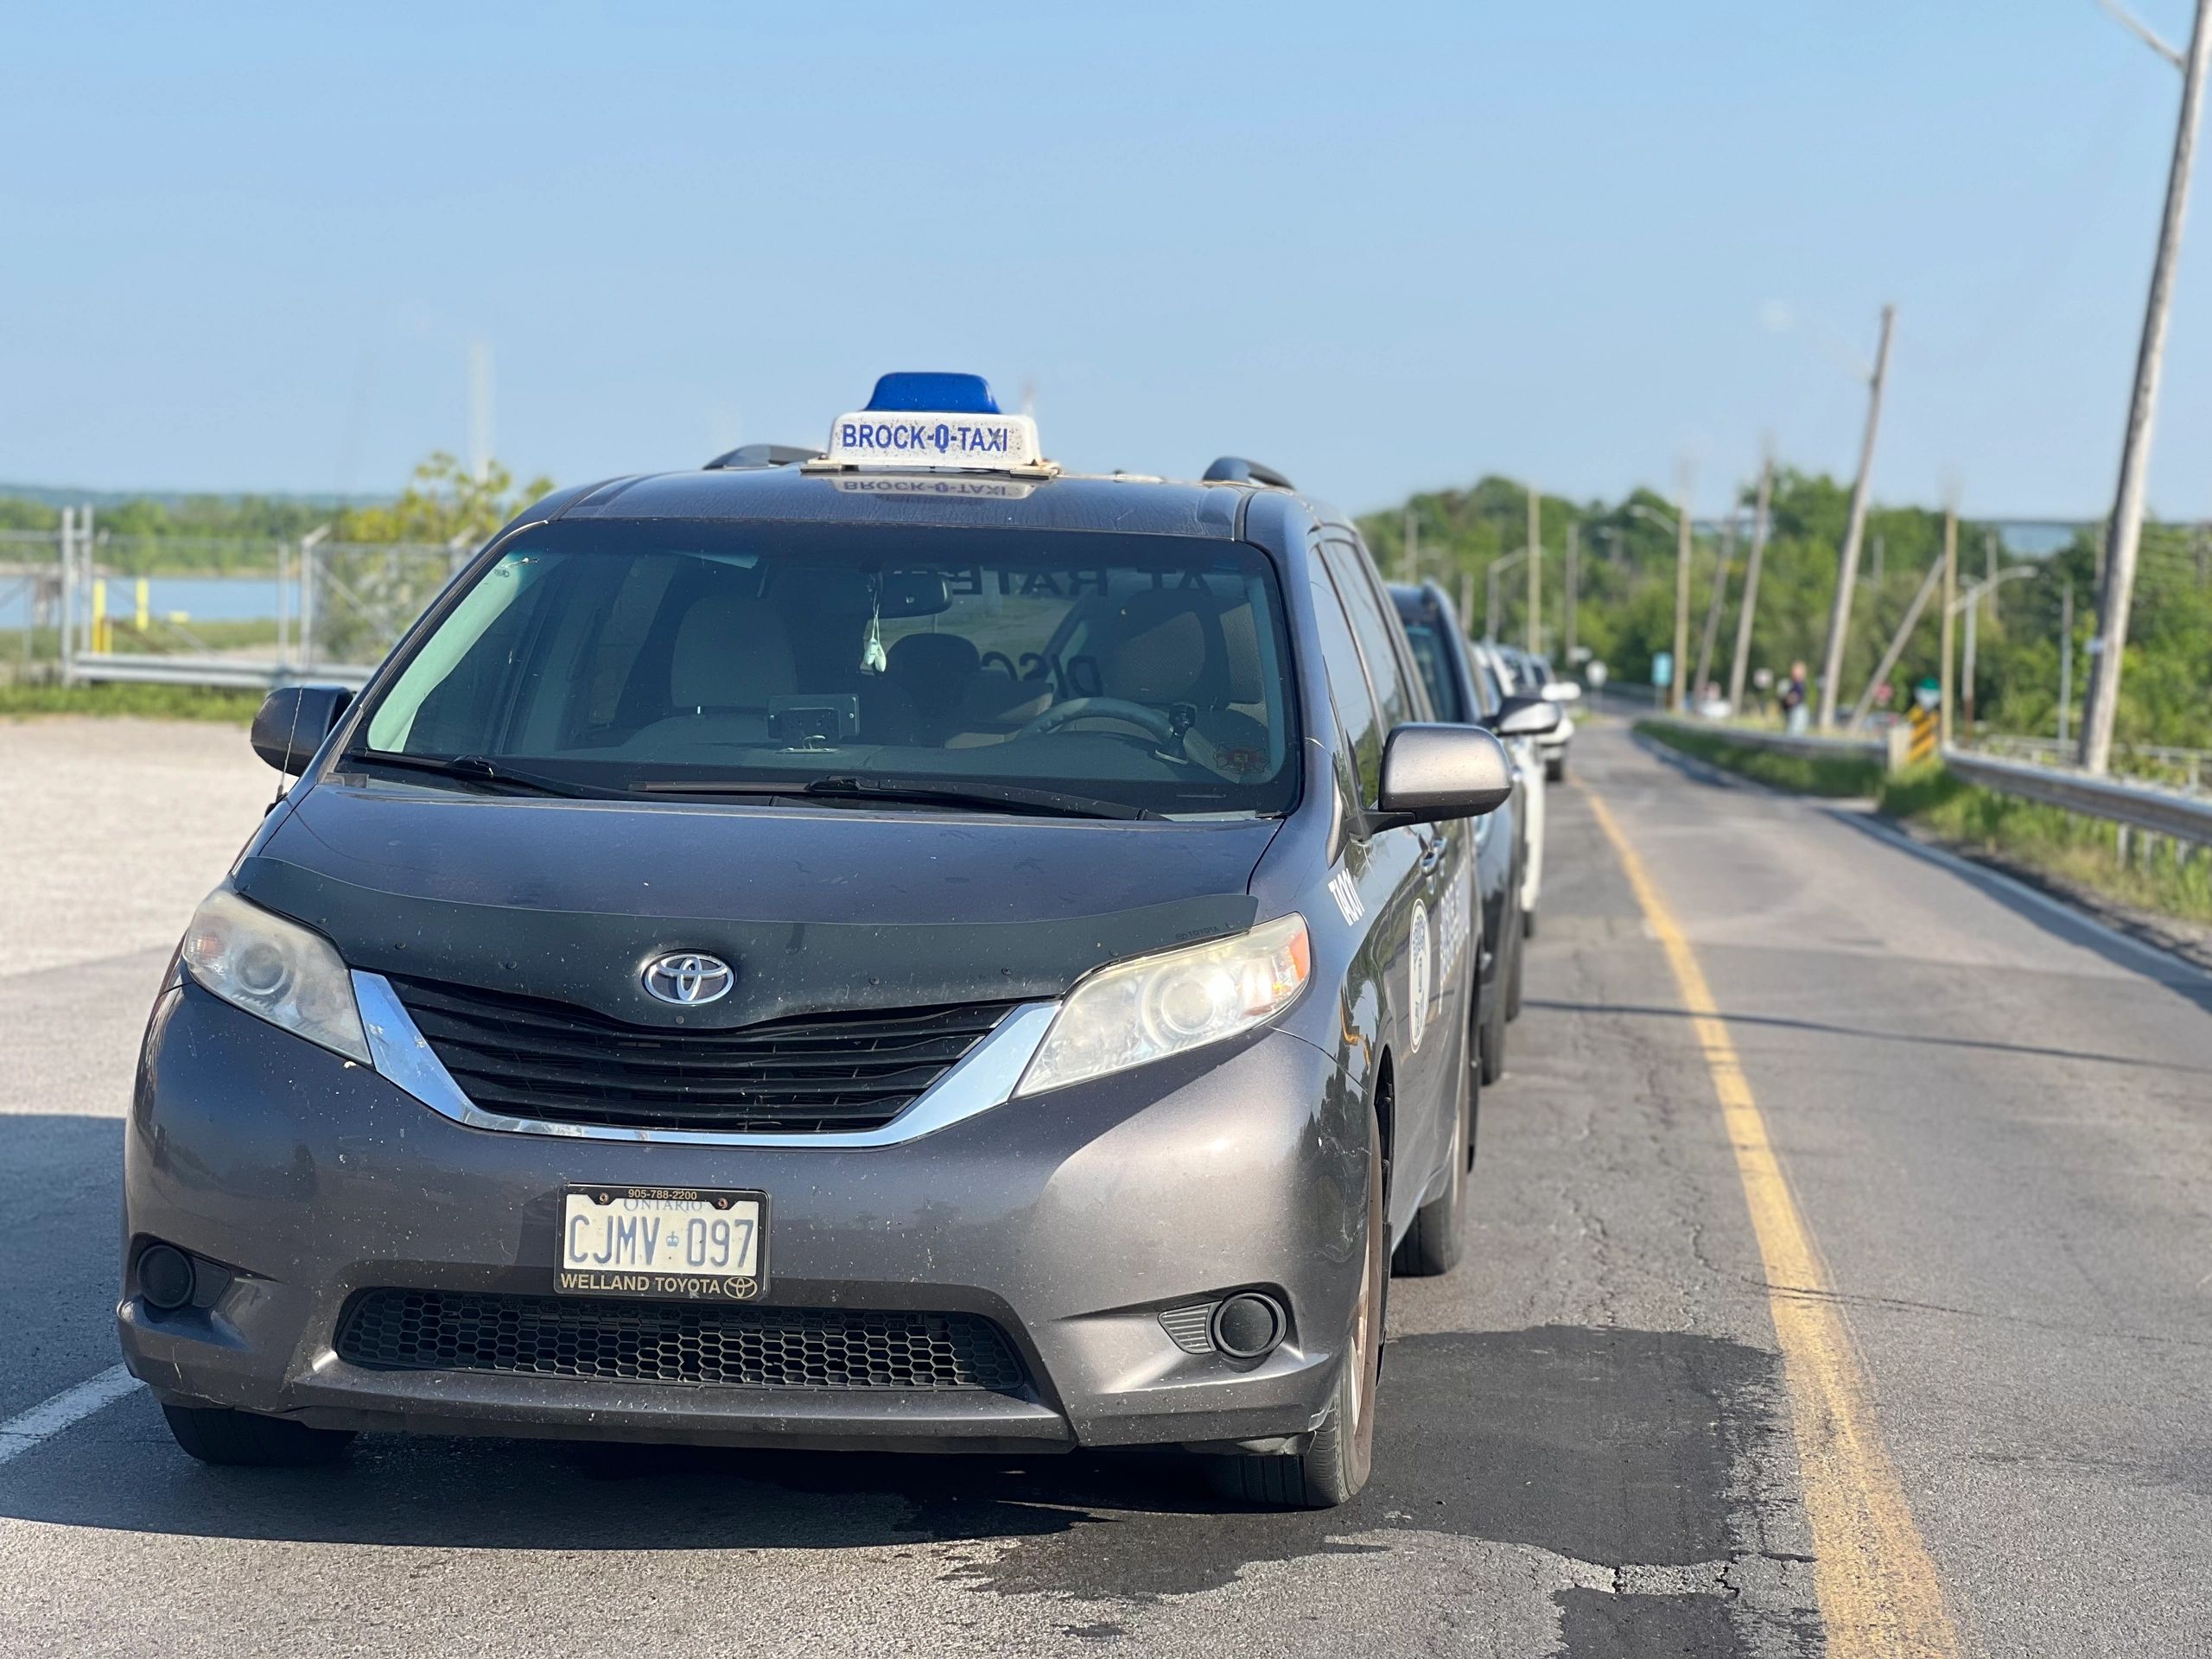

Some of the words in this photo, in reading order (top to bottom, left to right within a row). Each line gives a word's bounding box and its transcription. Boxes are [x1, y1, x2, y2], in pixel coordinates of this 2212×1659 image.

[1188, 925, 1219, 938] TOYOTA
[627, 1188, 697, 1200] 905-788-2200
[569, 1214, 661, 1265] CJMV
[686, 1217, 754, 1268] 097
[560, 1273, 649, 1292] WELLAND
[654, 1277, 721, 1294] TOYOTA
